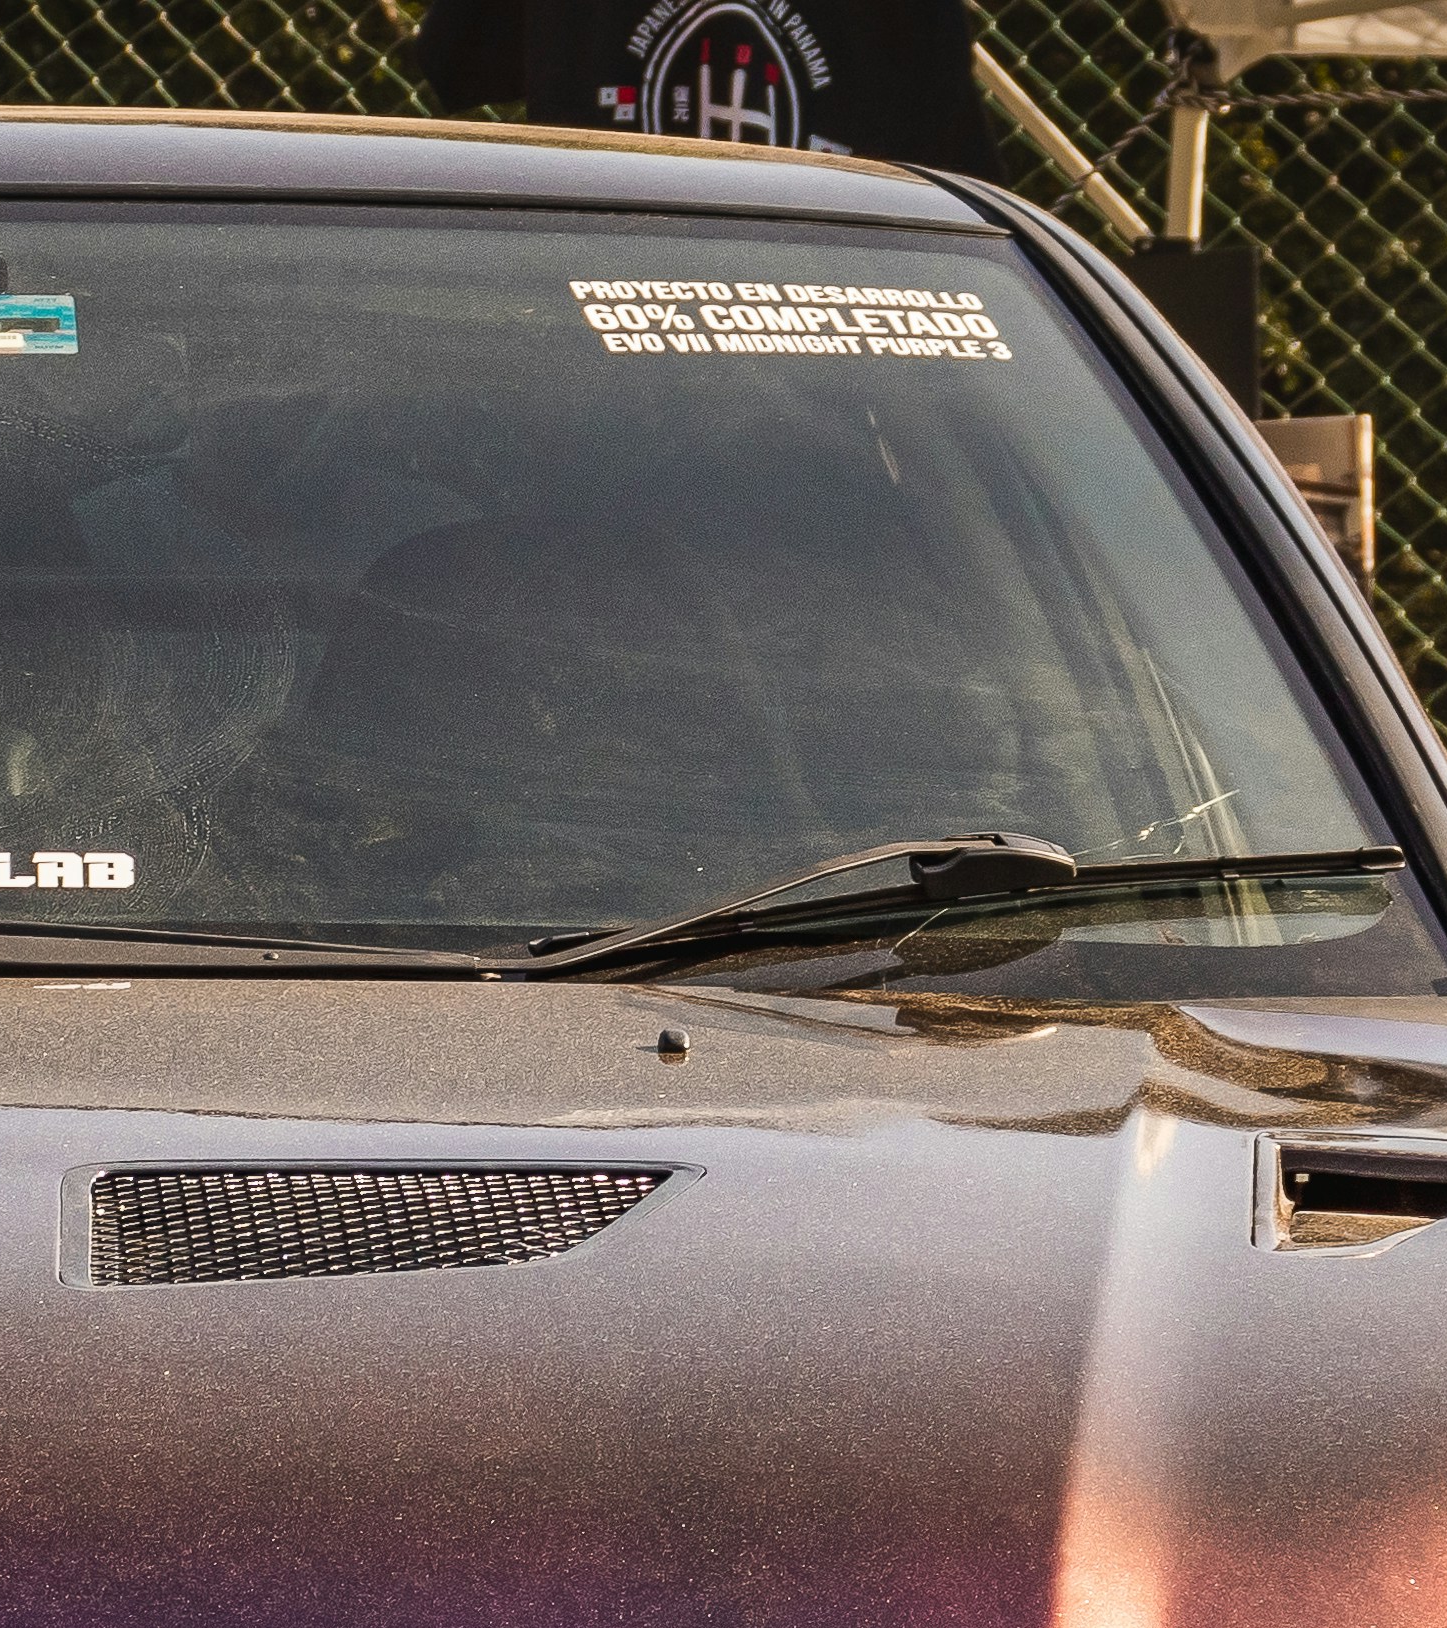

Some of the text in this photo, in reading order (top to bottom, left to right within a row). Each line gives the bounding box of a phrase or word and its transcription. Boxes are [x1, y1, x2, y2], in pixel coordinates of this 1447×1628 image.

[626, 0, 689, 58] JAPANE
[783, 12, 831, 90] PANAMA
[568, 280, 984, 311] PROYECTO EN DESARROLLO
[583, 302, 1000, 340] 60% COMPLETADO
[602, 333, 1014, 361] EVO VII MIDNIGHT PURPLE 3
